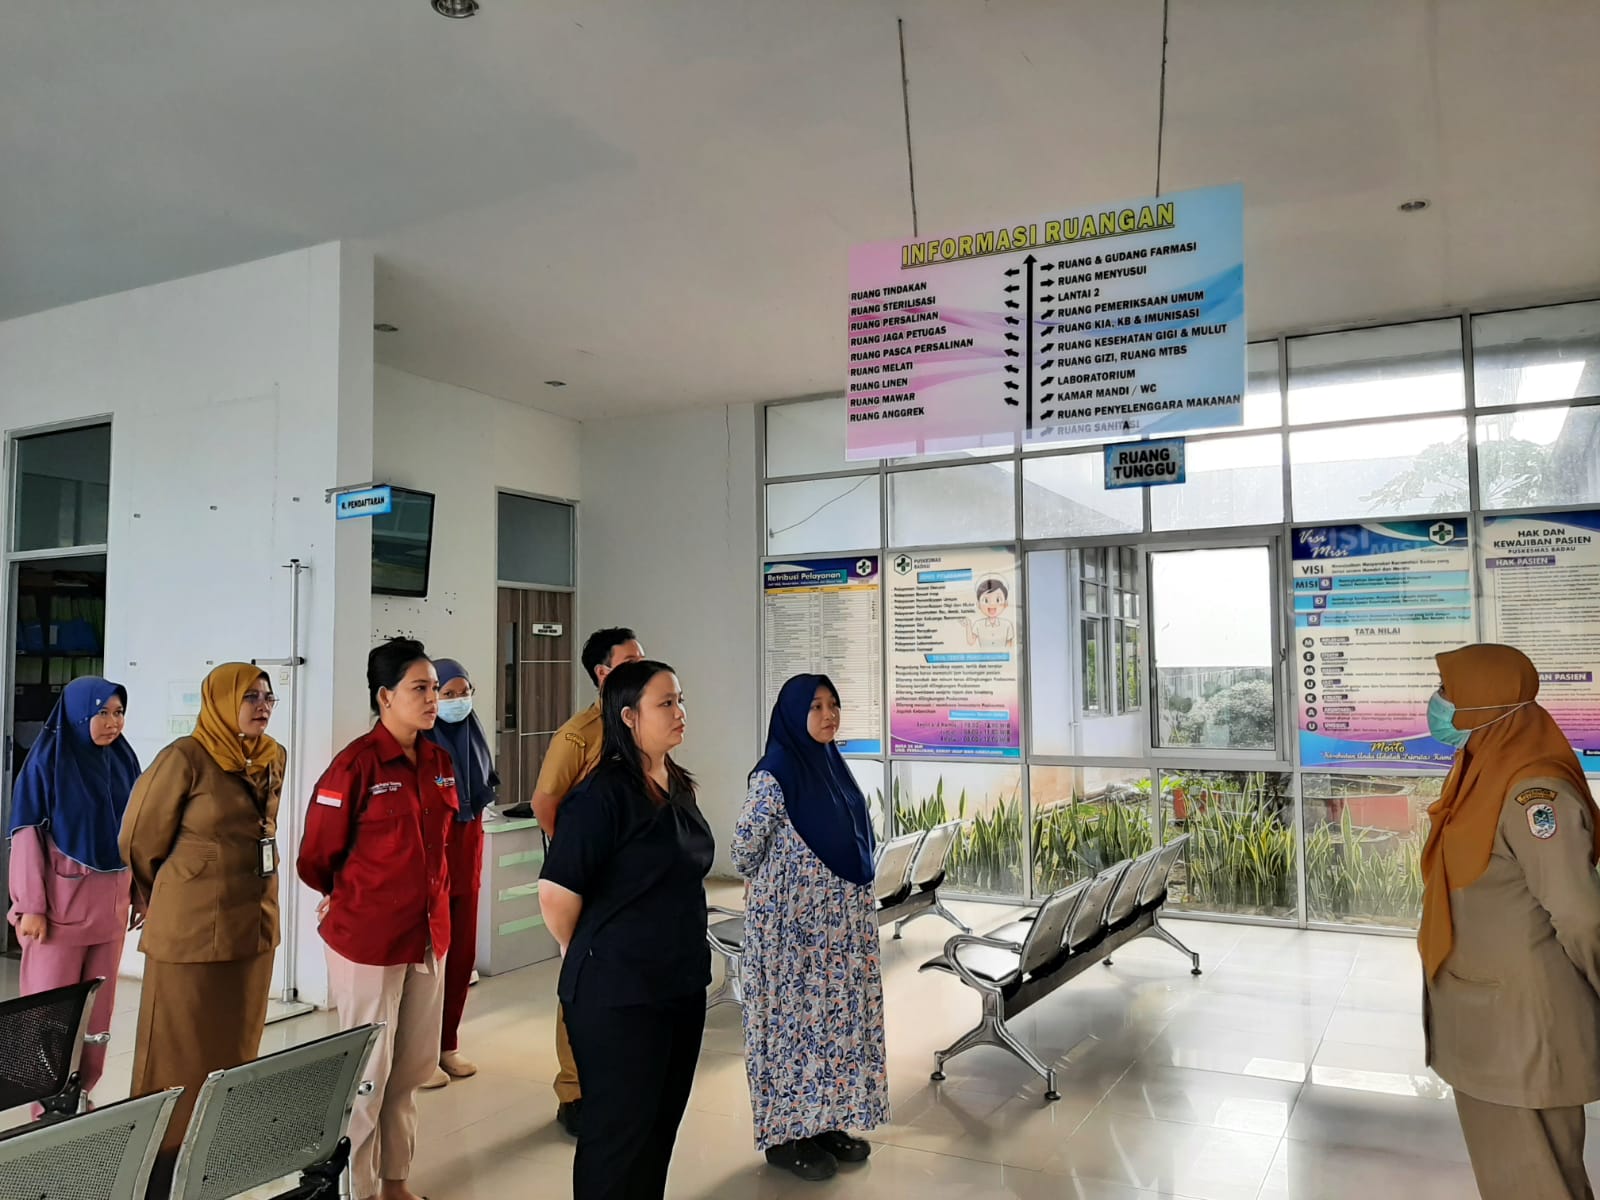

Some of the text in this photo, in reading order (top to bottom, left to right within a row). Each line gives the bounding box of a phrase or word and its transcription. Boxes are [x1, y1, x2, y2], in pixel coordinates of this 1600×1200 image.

[902, 202, 1174, 266] INFORMASI RUANGAN
[1058, 242, 1197, 270] RUANG & GUDANG FARMASI
[1058, 265, 1147, 286] RUANG MENYUSUI
[851, 282, 927, 301] RUANG TINDAKAN
[1058, 288, 1100, 302] LANTAI 2
[851, 296, 936, 316] RUANG STERILISASI
[1058, 291, 1204, 317] RUANG PEMERIKSAAN UMUM
[851, 311, 939, 331] RUANG PERSALINAN
[1058, 322, 1092, 334] RUANG
[1118, 316, 1131, 327] KB
[1134, 315, 1141, 325] &
[1145, 308, 1199, 323] IMUNISASI
[851, 326, 946, 346] RUANG JAGA PETUGAS
[1058, 324, 1227, 351] RUANG KESEHATAN GIGI & MULUT
[850, 338, 973, 361] RUANG PASCA PERSALINAN
[1058, 345, 1187, 367] RUANG GIZI, RUANG MTBS
[850, 362, 913, 376] RUANG MELATI
[1058, 369, 1136, 385] LABORATORIUM
[850, 378, 908, 392] RUANG LINEN
[1058, 384, 1157, 401] KAMAR MANDI / WC
[850, 393, 915, 407] RUANG MAWAR
[1058, 394, 1241, 419] RUANG PENYELENGGARA MAKANAN
[850, 407, 925, 422] RUANG ANGGREK
[1058, 420, 1140, 435] RUANG SANITASI
[1119, 448, 1170, 465] RUANG
[1113, 462, 1176, 479] TUNGGU
[348, 496, 385, 509] PENDAFTARAN
[1299, 529, 1327, 544] Visi
[1518, 528, 1565, 538] HAK DAN
[1494, 536, 1591, 548] KEWAJIBAN PASIEN
[1310, 543, 1350, 558] Misi
[1517, 557, 1548, 566] PASIEN
[767, 571, 841, 582] Retribusi Pelayanan
[1301, 565, 1324, 575] VISI
[1295, 580, 1318, 588] MISI
[1378, 627, 1400, 635] NILAI
